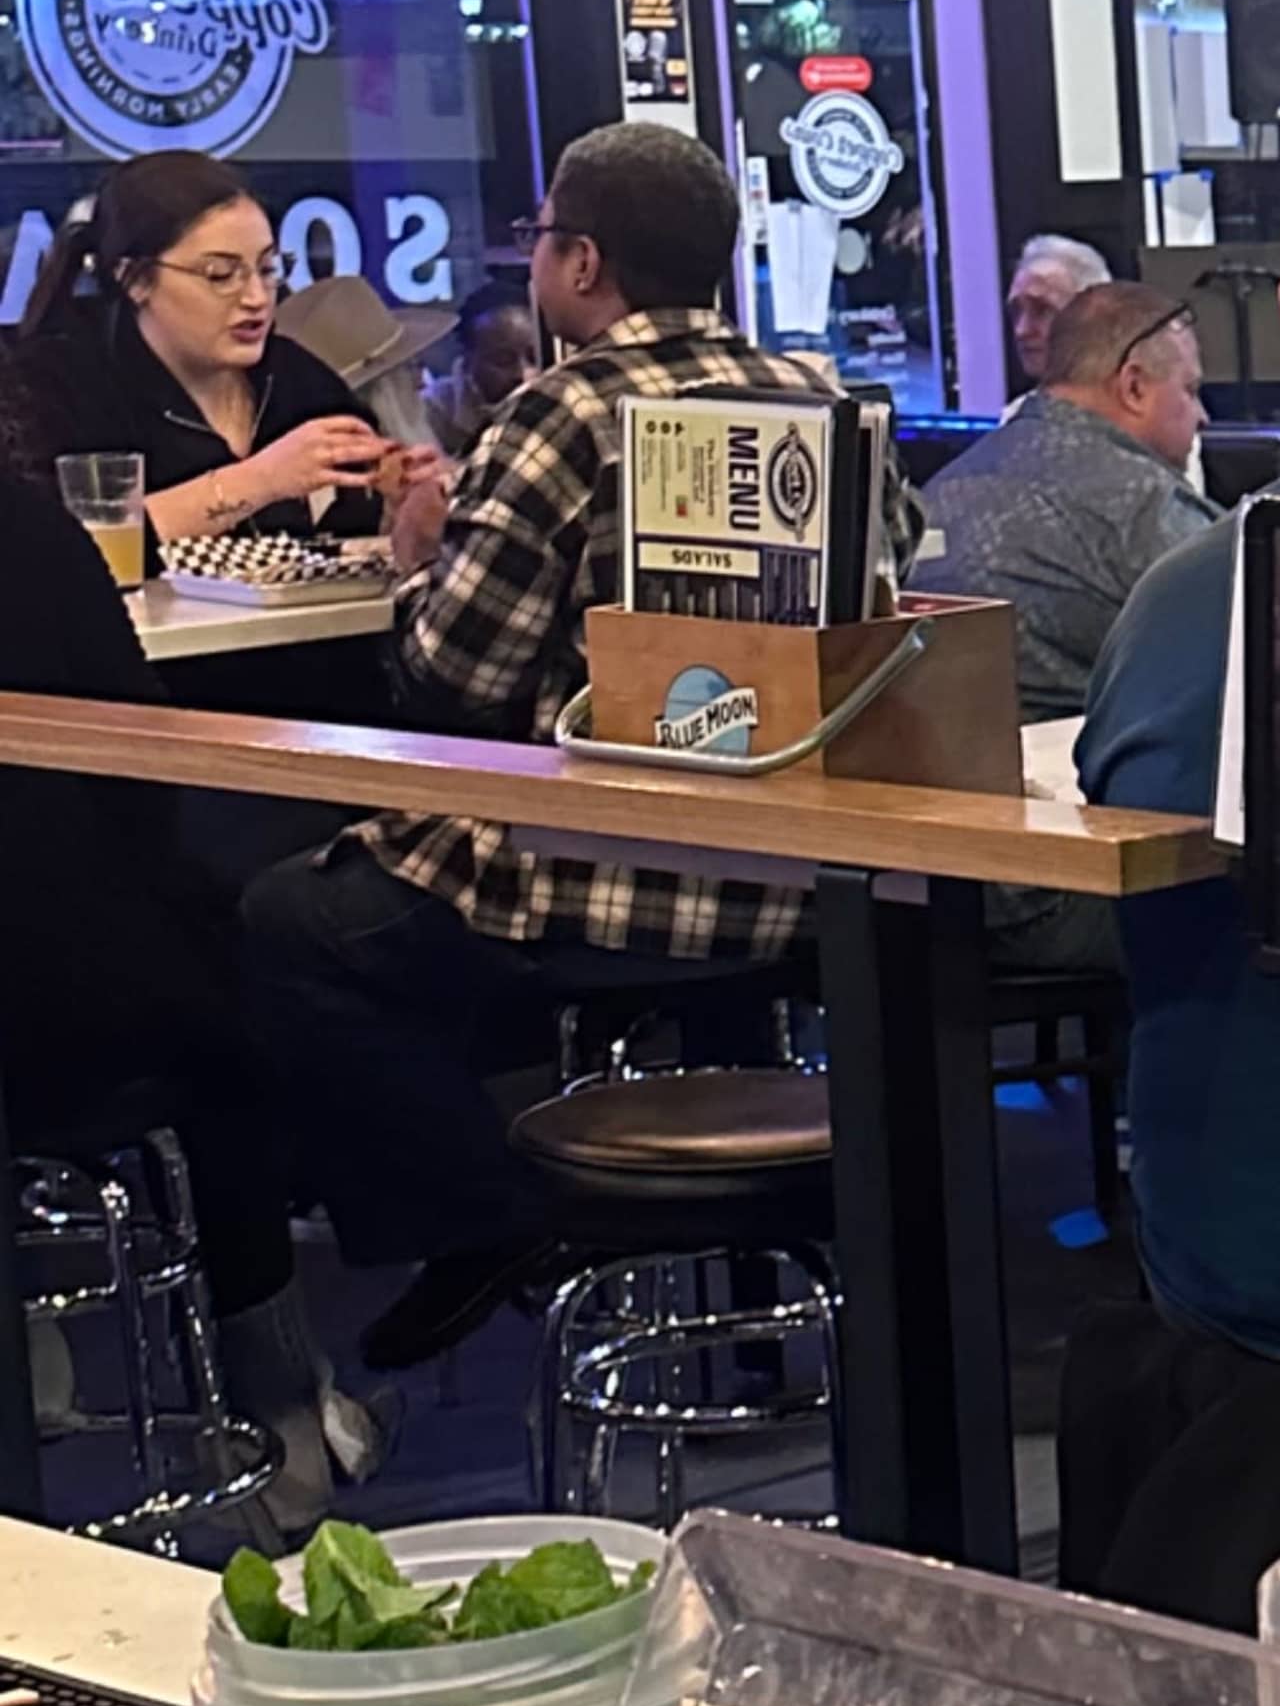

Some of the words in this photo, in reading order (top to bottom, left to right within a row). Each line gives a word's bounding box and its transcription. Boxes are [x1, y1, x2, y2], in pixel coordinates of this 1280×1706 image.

[728, 425, 760, 532] MENU
[671, 549, 733, 569] SALADS
[658, 717, 705, 750] BLUE
[705, 693, 757, 734] MOON
